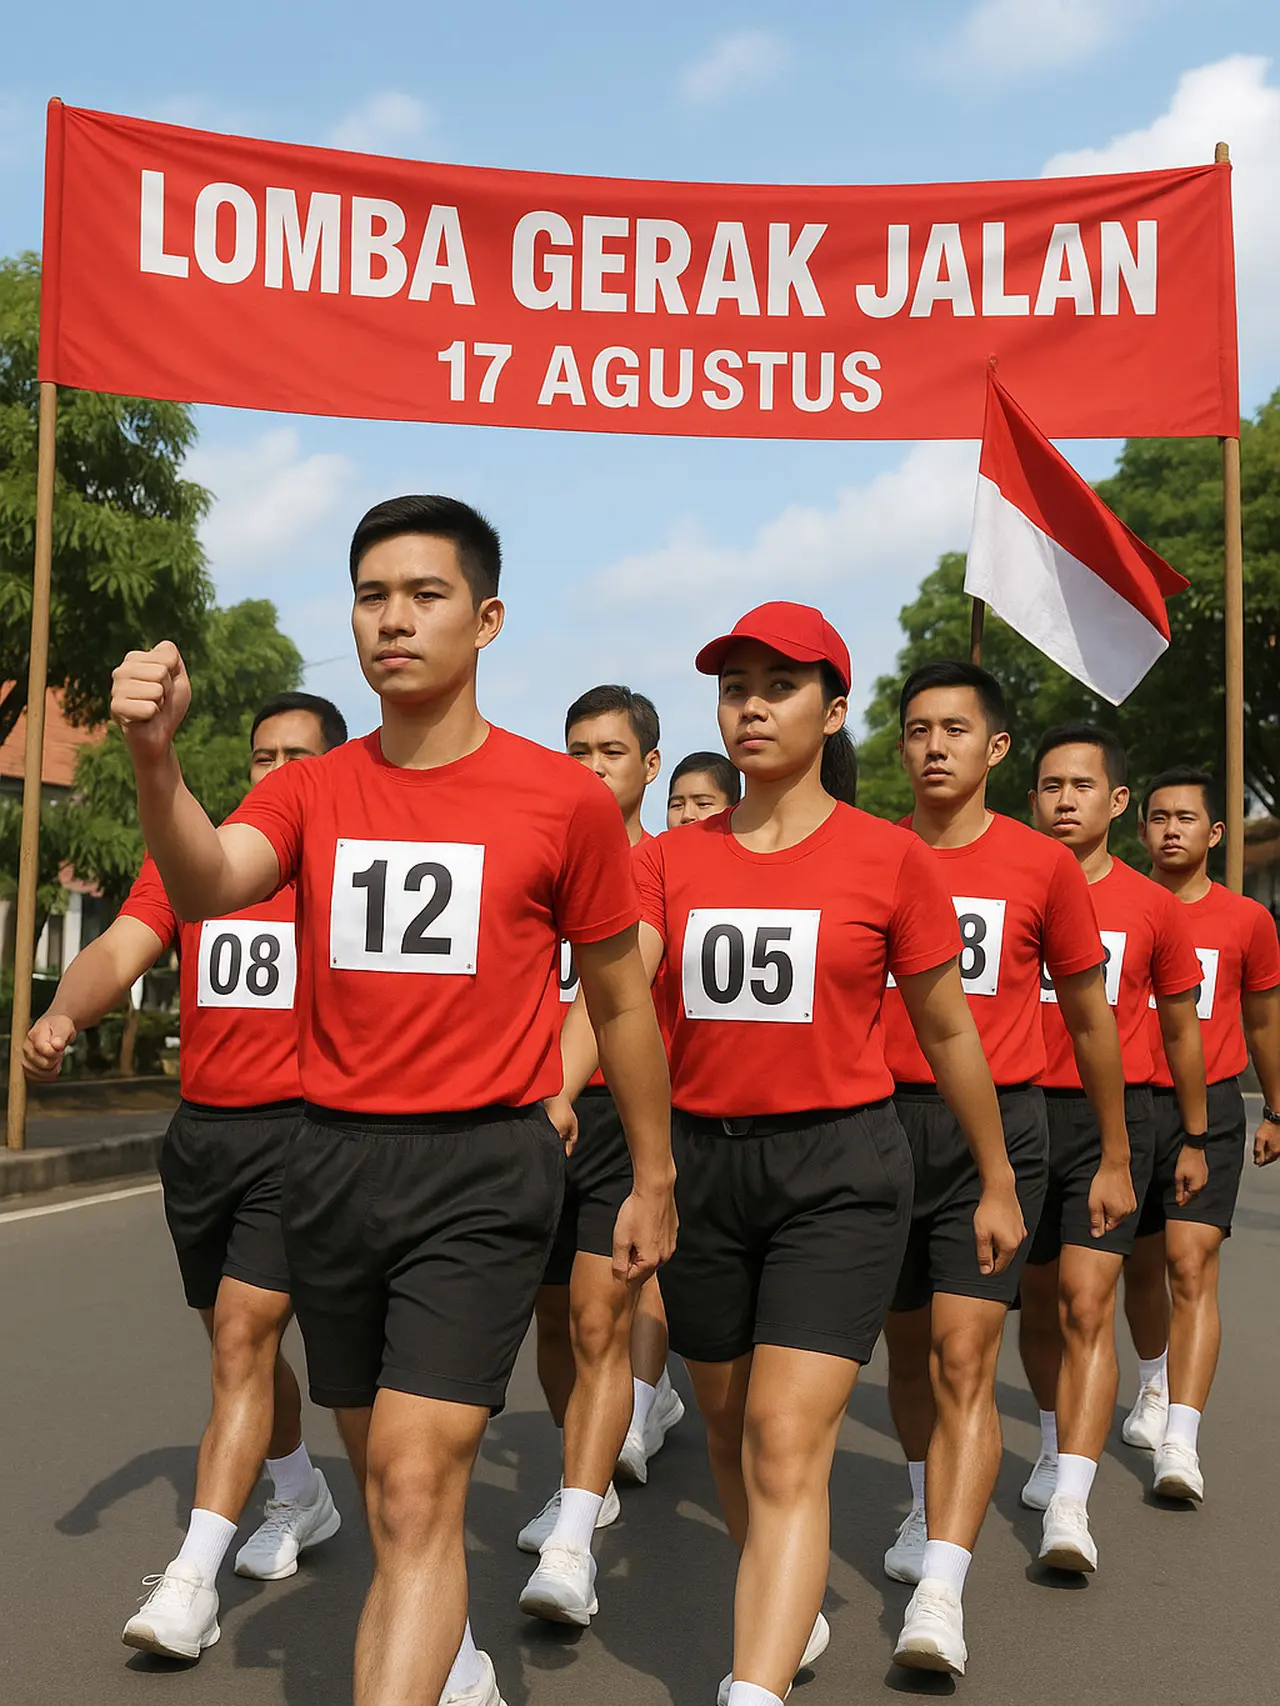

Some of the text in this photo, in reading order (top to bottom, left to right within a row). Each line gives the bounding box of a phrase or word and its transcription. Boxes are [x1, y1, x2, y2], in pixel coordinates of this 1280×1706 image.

[139, 169, 1158, 319] LOMBA GERAK JALAN
[437, 340, 882, 413] 17 AGUSTUS
[352, 859, 453, 955] 12
[209, 933, 281, 997] 08
[701, 924, 793, 1006] 05
[957, 912, 987, 980] 8
